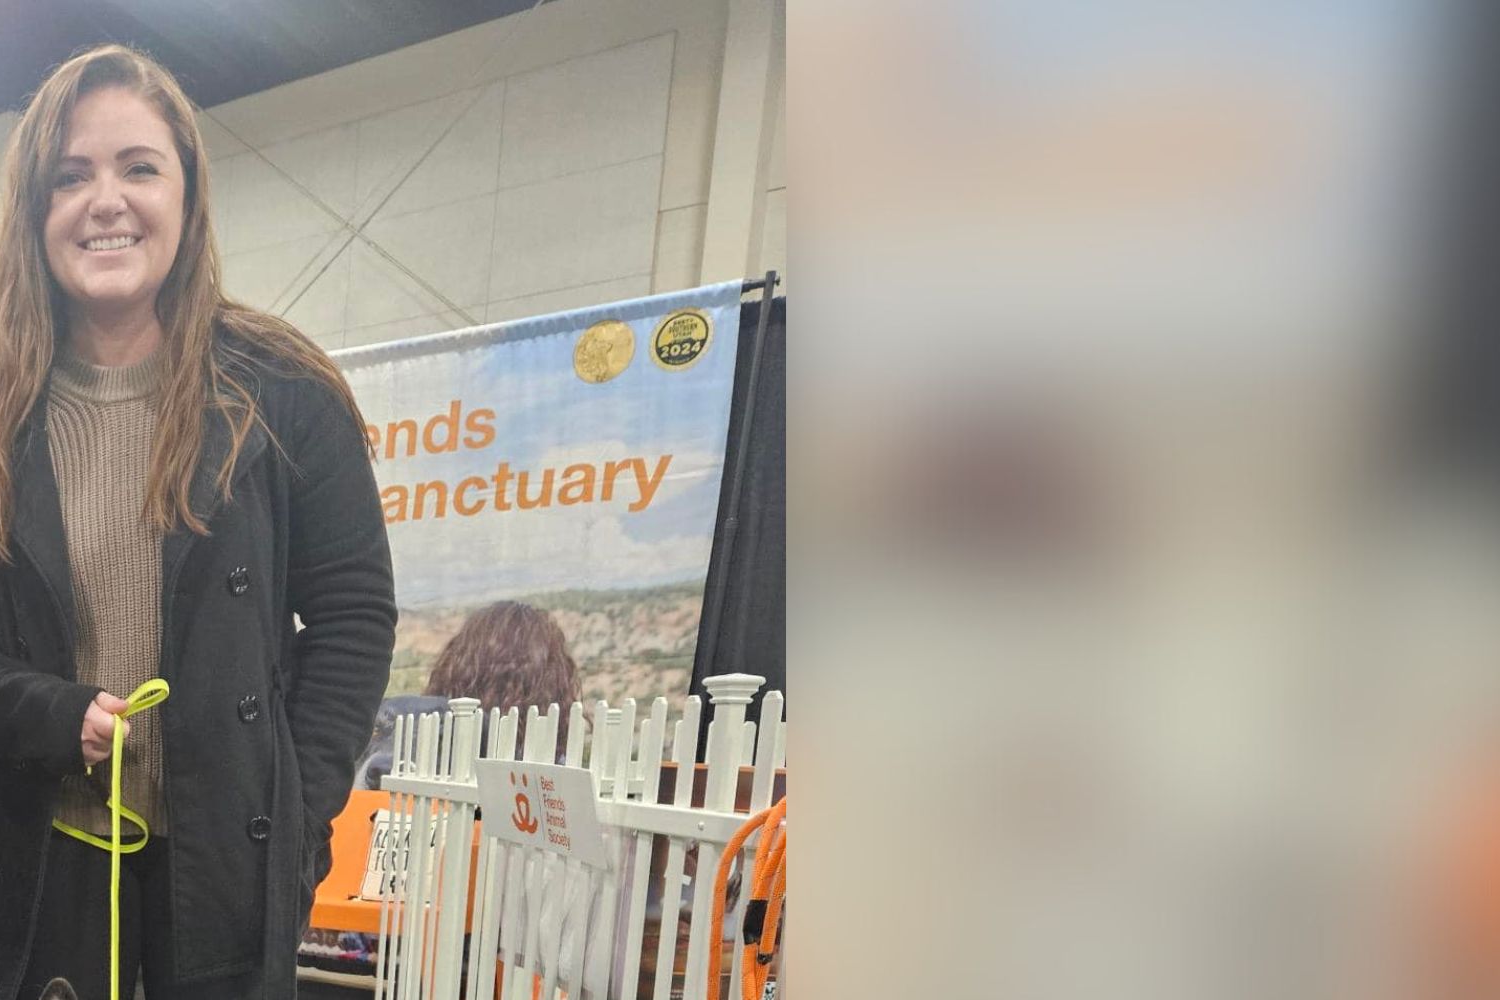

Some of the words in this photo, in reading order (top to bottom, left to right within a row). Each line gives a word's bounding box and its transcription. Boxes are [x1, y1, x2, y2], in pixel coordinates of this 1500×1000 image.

[660, 341, 701, 357] 2024
[540, 776, 555, 791] Best
[542, 794, 566, 812] Friends
[546, 812, 566, 829] Animal
[548, 829, 571, 850] Society
